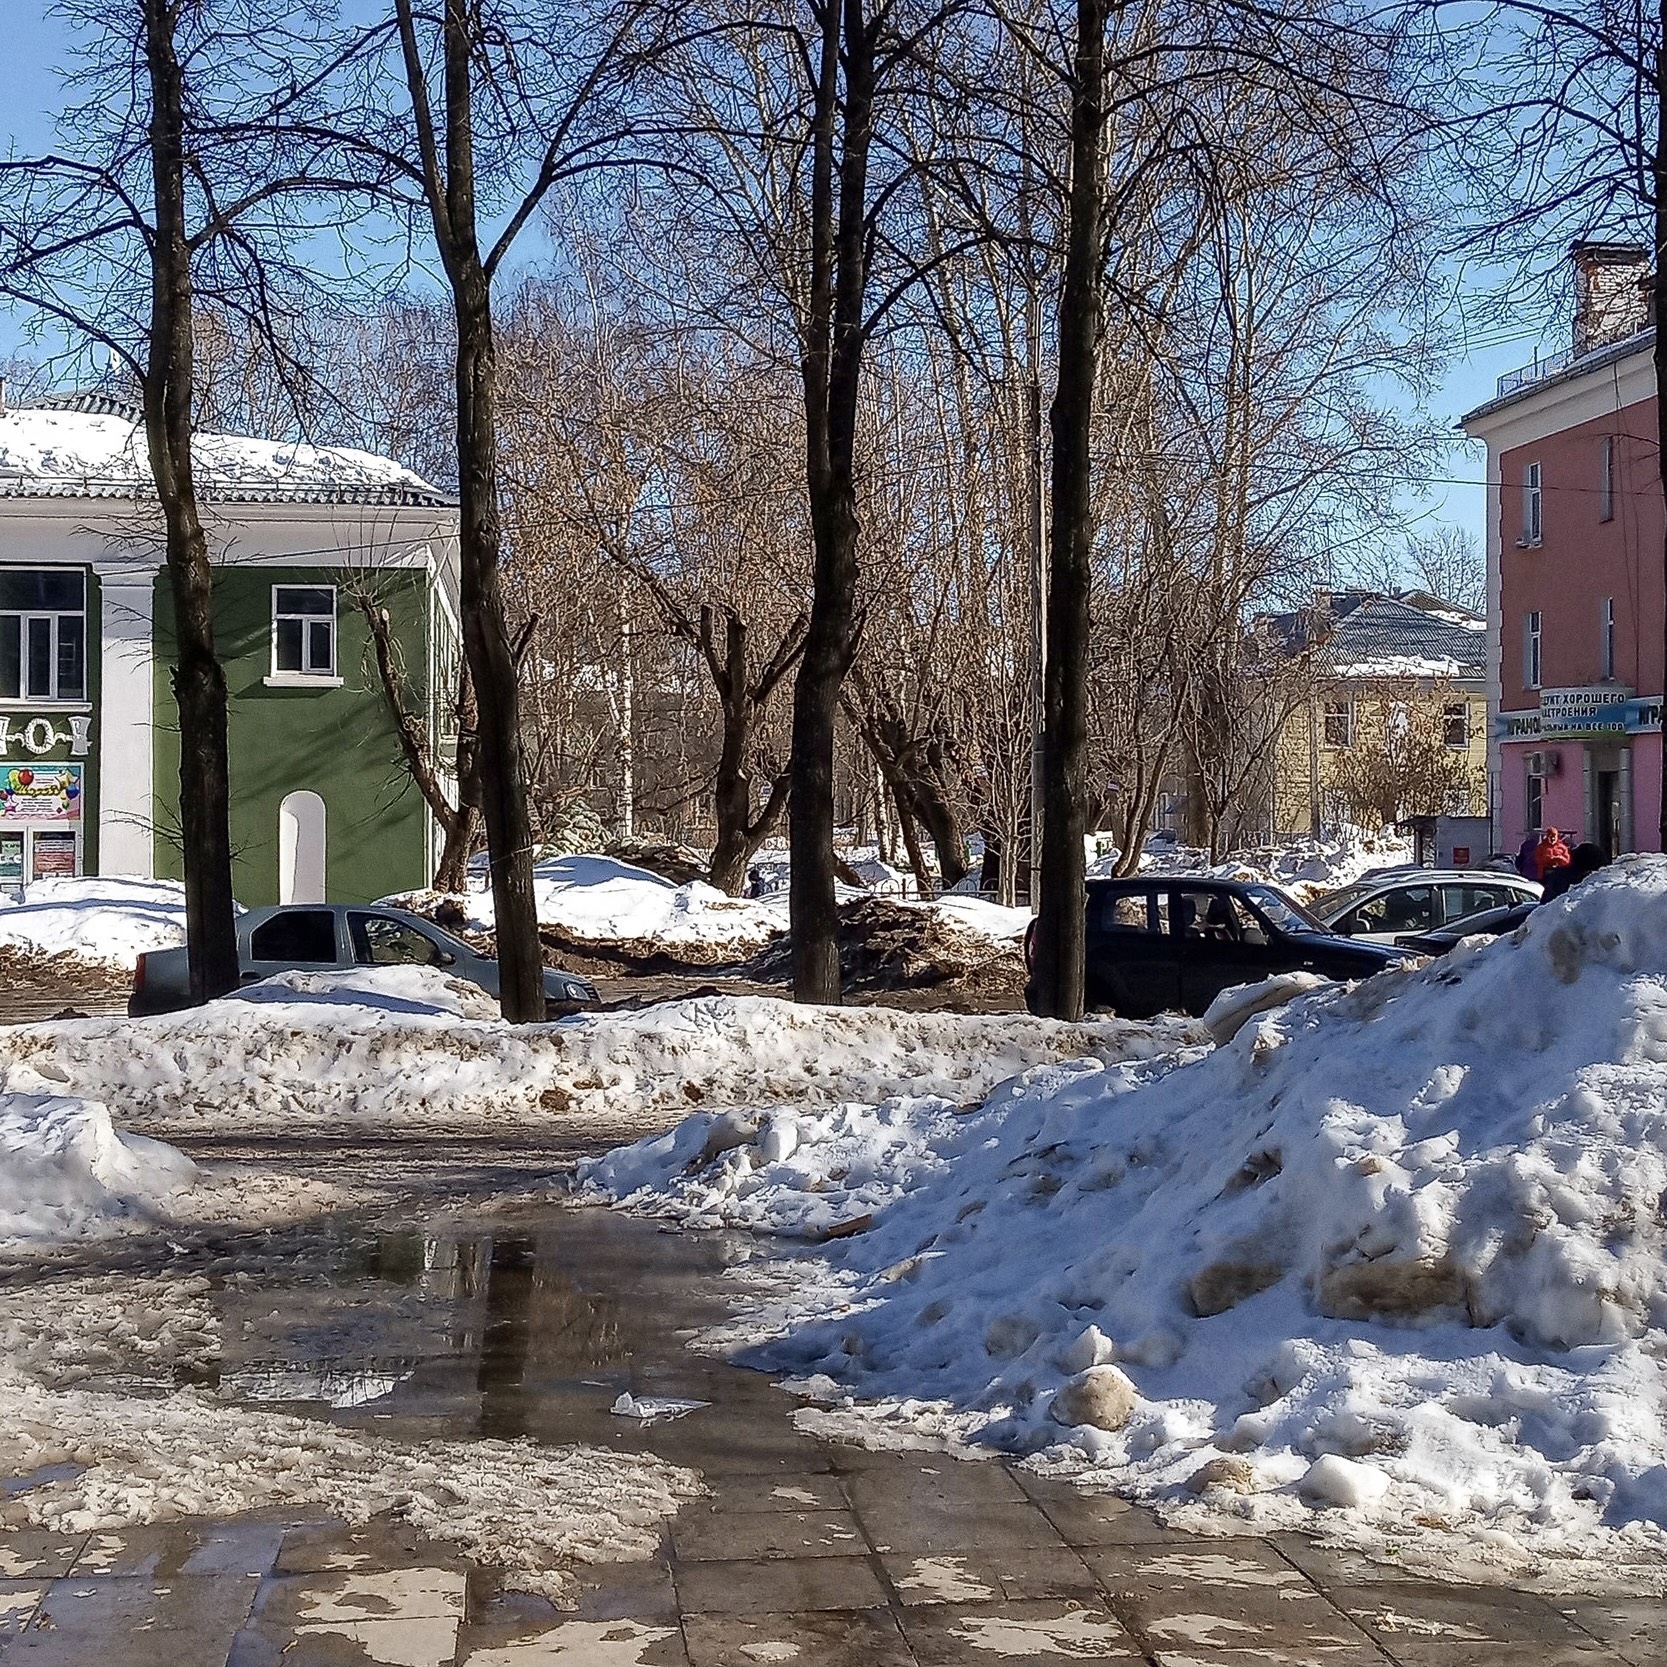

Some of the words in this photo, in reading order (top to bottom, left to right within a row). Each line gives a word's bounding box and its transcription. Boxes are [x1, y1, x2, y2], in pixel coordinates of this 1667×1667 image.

[1563, 693, 1625, 705] ХОРОШЕГО
[1571, 723, 1582, 731] НА
[1585, 722, 1603, 731] ВСЕ
[1608, 722, 1623, 731] 100
